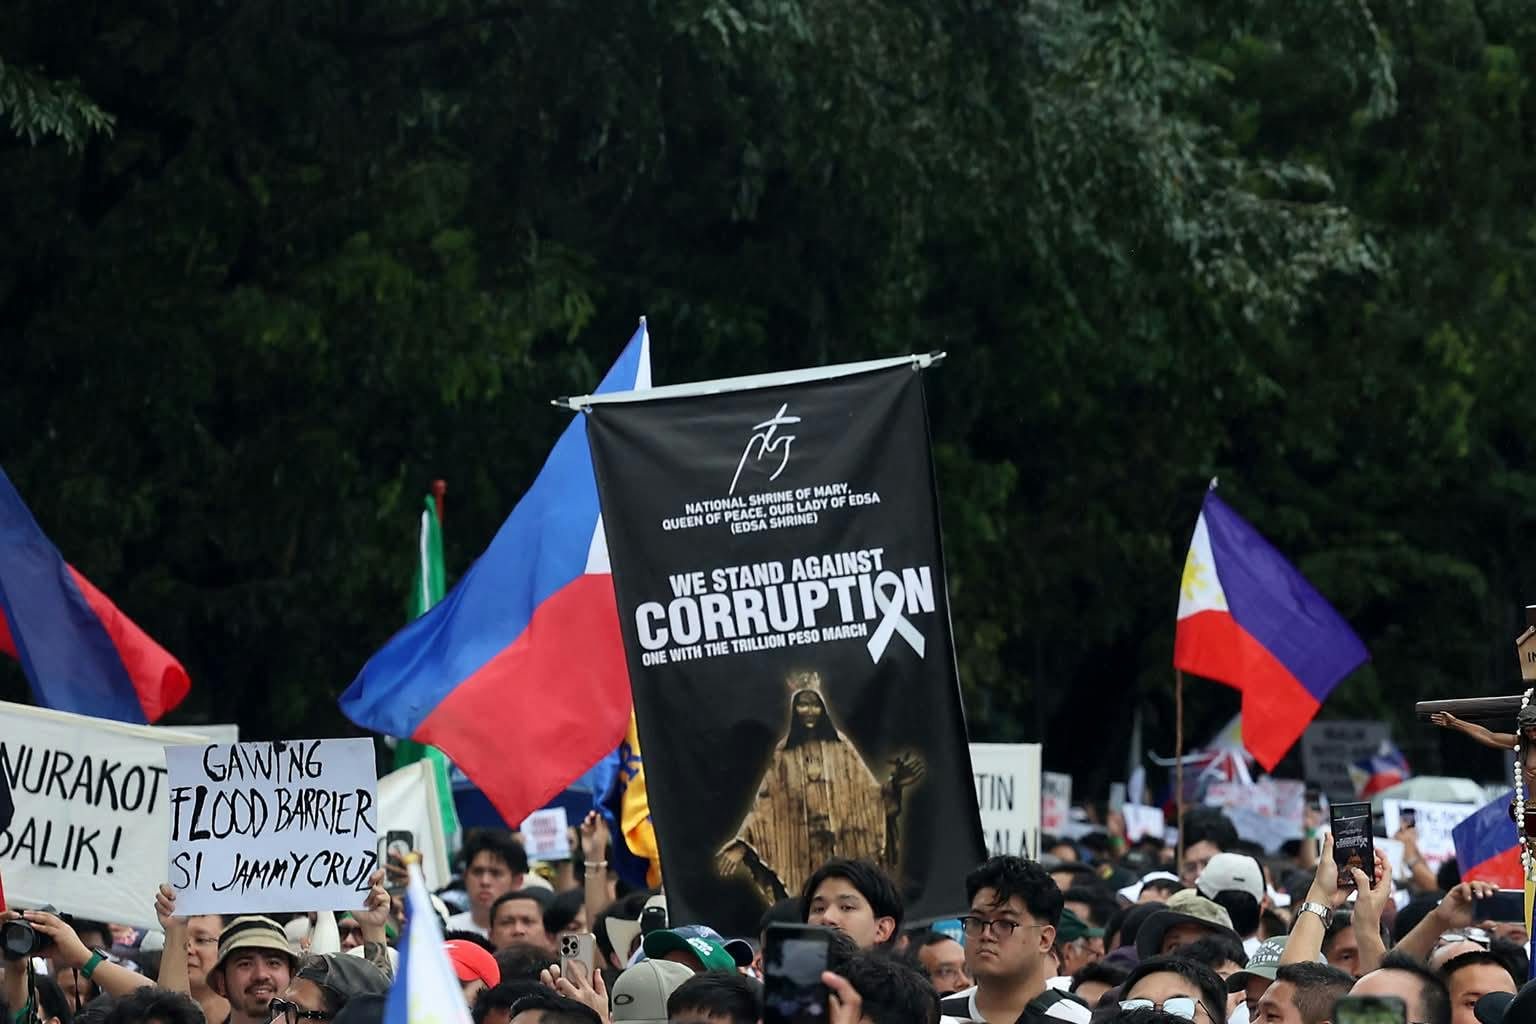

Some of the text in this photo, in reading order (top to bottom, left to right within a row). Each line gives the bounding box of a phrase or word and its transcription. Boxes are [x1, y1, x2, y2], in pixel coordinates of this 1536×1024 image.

[662, 515, 702, 531] QUEEN
[706, 513, 721, 524] OF
[769, 503, 795, 516] OUR
[797, 498, 828, 513] LADY
[831, 496, 846, 508] OF
[849, 492, 881, 506] EDSA
[685, 497, 747, 515] NATIONAL
[749, 491, 793, 507] SHRINE
[796, 488, 811, 500] OF
[731, 511, 818, 535] (EDSA SHRINE)
[669, 548, 884, 597] WE STAND AGAINST
[635, 566, 935, 650] CORRUPTION
[642, 623, 867, 667] ONE WITH THE TRILLION PESO MARCH
[171, 785, 377, 841] FLOOD BARRIER
[173, 850, 377, 896] SI JAMMY CRUZ
